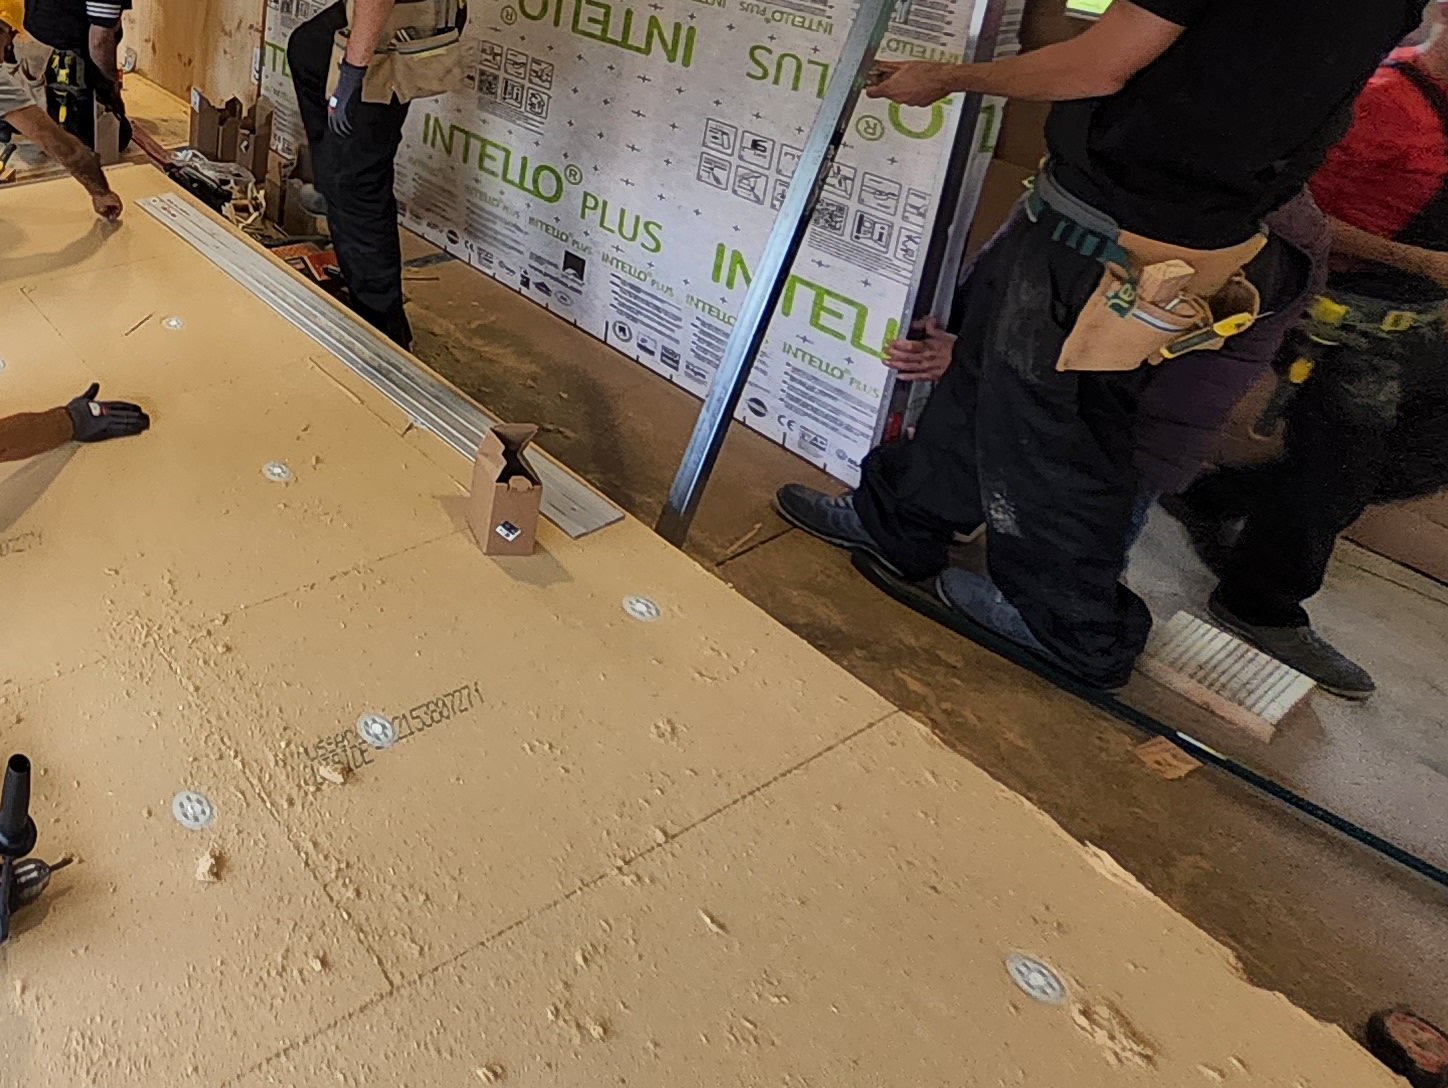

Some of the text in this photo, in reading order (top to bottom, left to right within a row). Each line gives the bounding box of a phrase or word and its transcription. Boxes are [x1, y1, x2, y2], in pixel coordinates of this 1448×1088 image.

[746, 44, 830, 99] LUS
[580, 191, 662, 254] PLUS
[849, 376, 880, 399] PLUS
